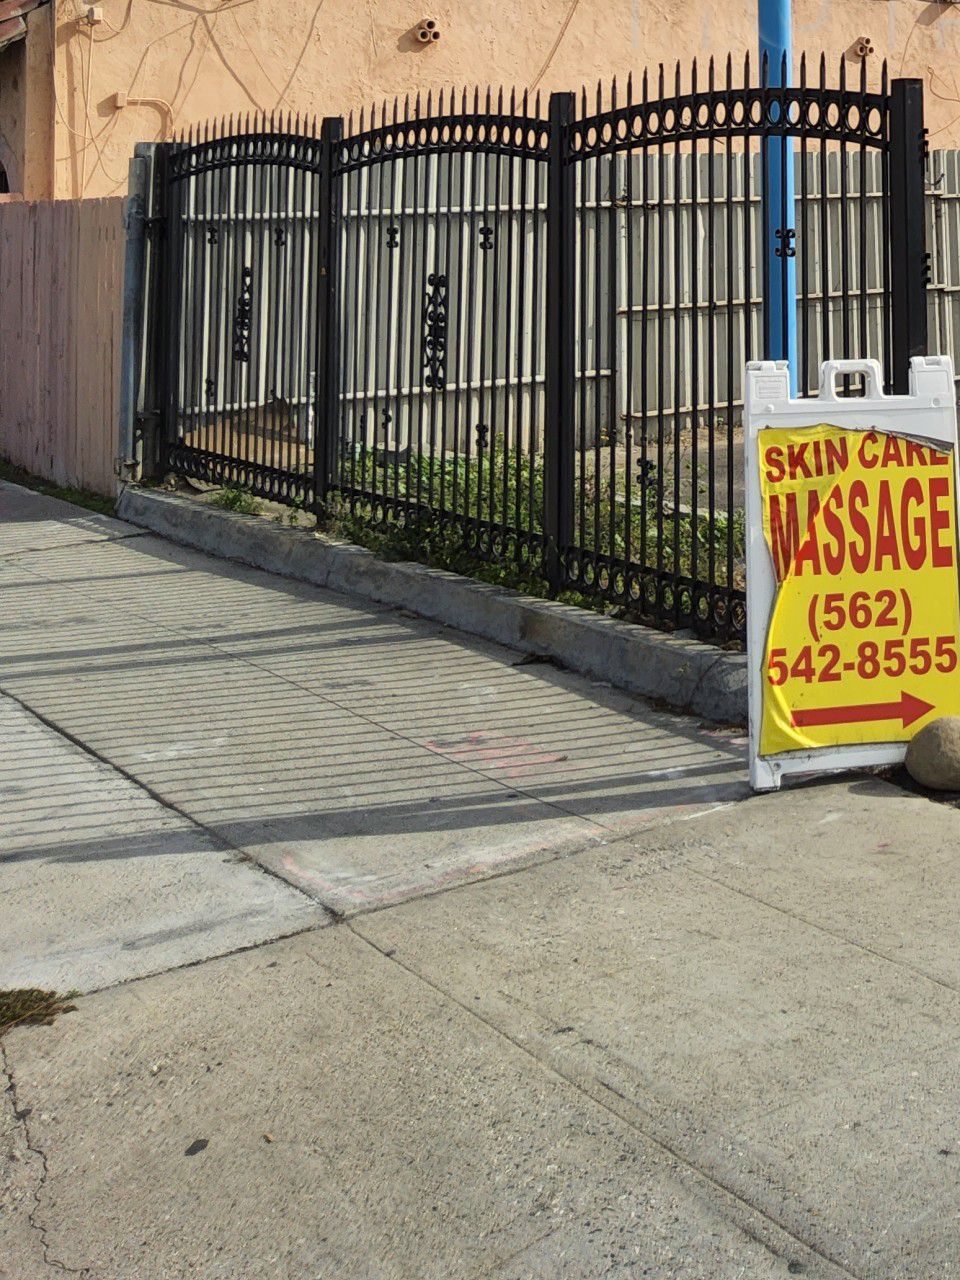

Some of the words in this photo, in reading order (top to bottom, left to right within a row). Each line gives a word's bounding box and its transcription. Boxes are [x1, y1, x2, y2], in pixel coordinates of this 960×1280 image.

[764, 436, 849, 484] SKIN
[768, 476, 954, 583] MASSAGE
[808, 588, 913, 643] (562)
[767, 635, 959, 687] 542-8555
